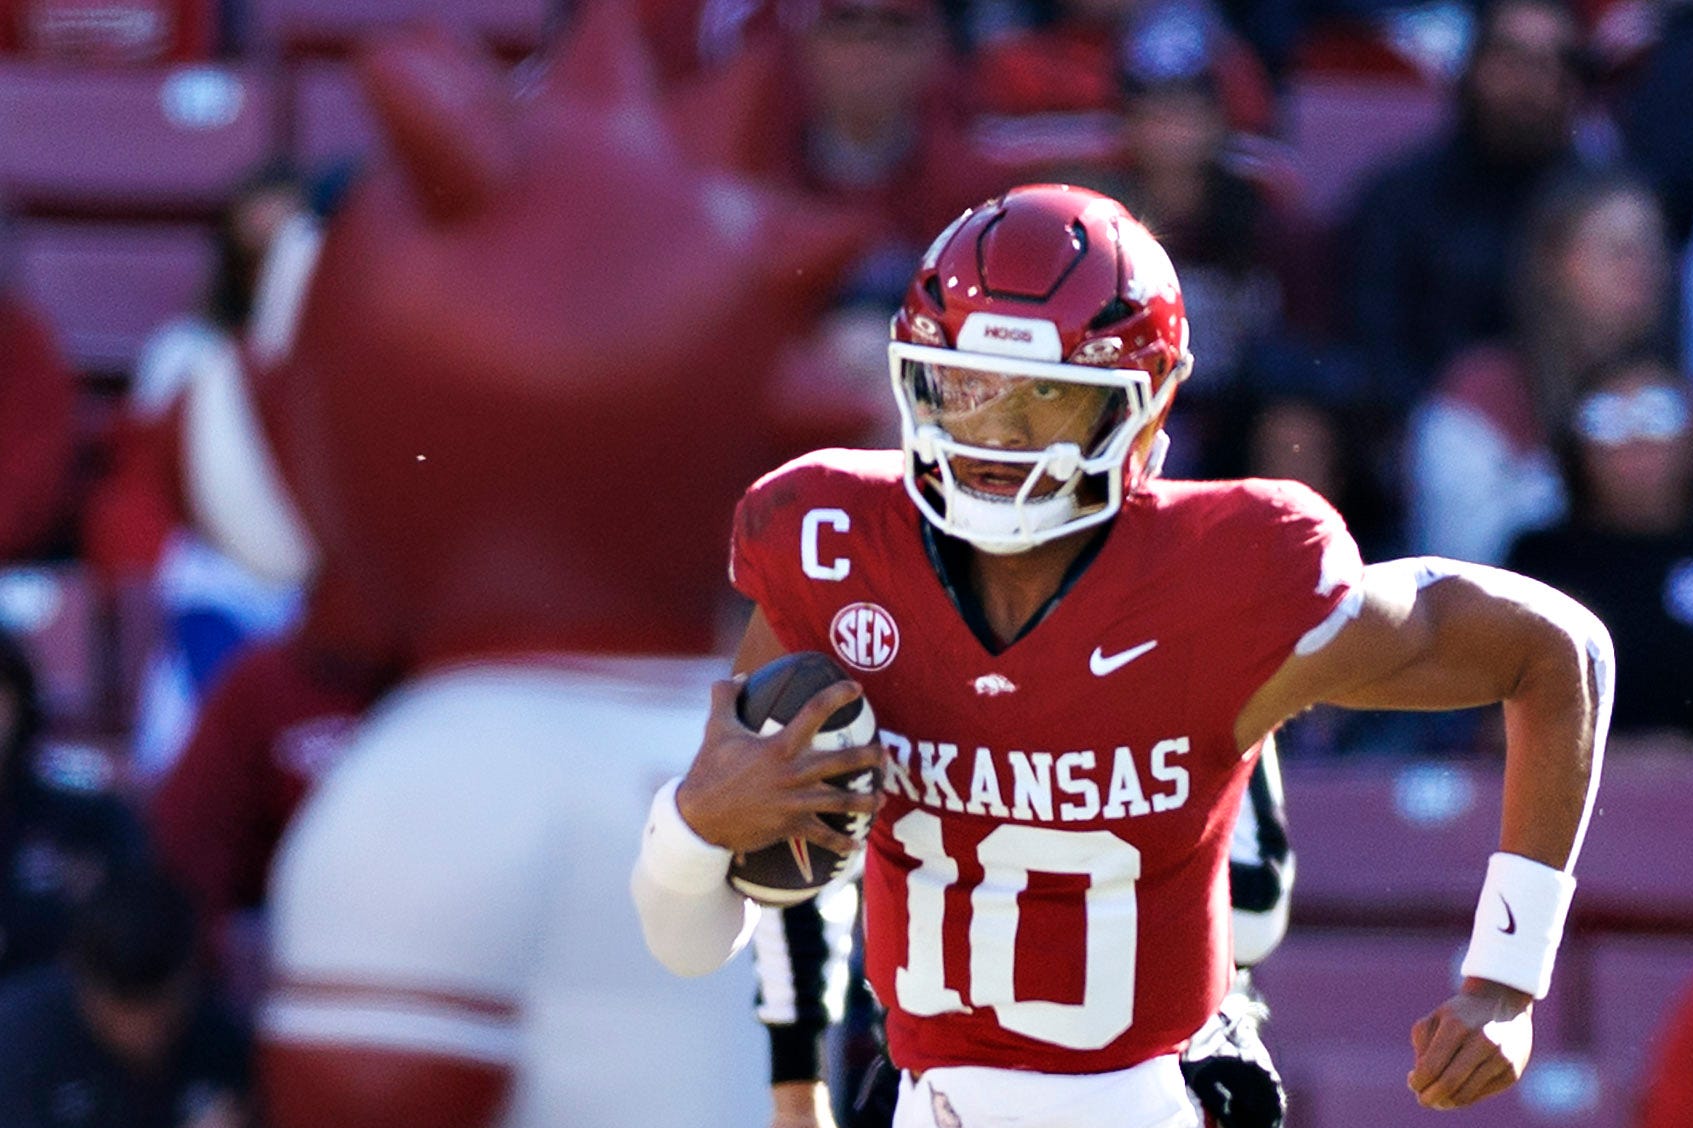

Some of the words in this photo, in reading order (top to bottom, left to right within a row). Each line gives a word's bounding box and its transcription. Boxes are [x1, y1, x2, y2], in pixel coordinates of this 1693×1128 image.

[984, 324, 1033, 343] HOGS
[801, 507, 850, 581] C
[836, 608, 892, 666] SEC
[877, 728, 1190, 821] RKANSAS
[893, 808, 1141, 1050] 10
